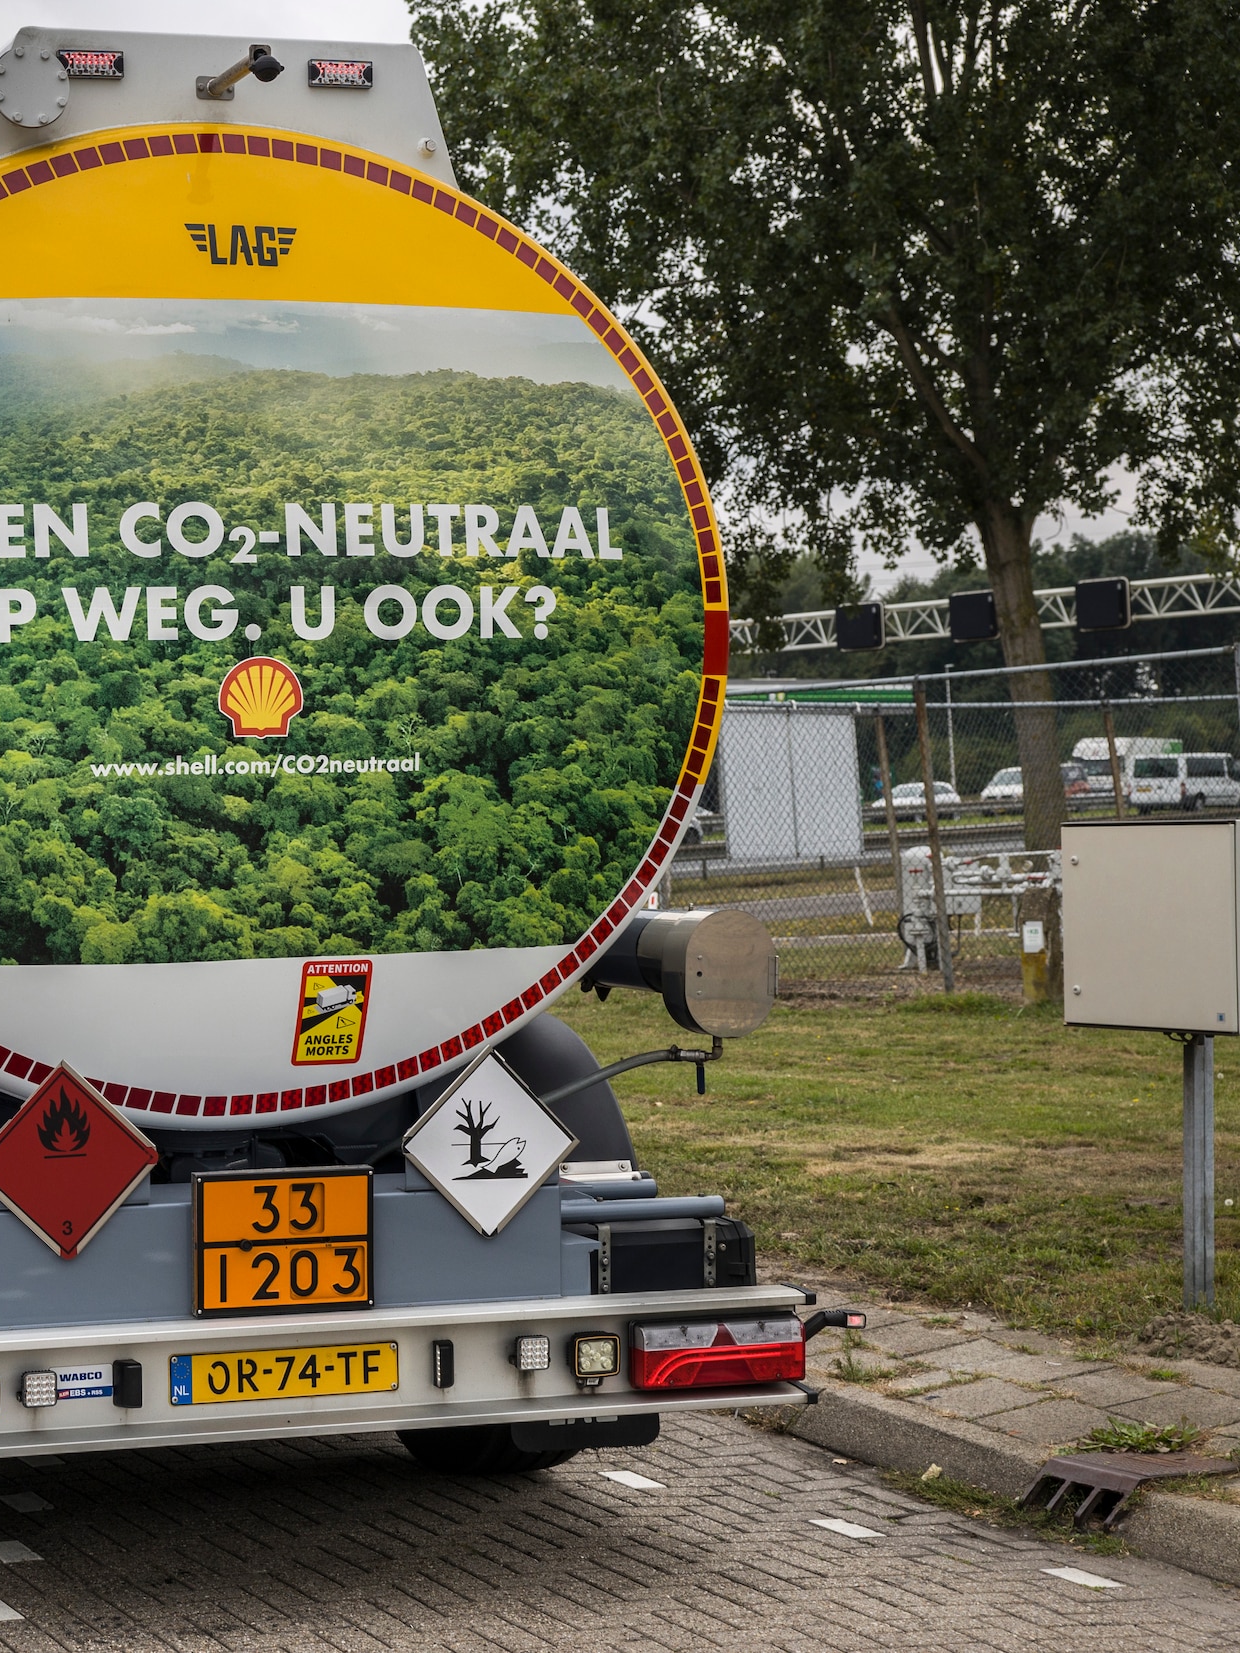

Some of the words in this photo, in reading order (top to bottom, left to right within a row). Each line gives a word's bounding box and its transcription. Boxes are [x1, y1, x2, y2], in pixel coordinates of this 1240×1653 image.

[207, 223, 279, 267] LAG
[61, 584, 262, 642] WEG.
[290, 585, 336, 641] U
[363, 584, 557, 641] OOK?
[90, 752, 420, 777] www.shell.com/CO2neutraal
[307, 963, 369, 974] ATTENTION
[305, 1034, 354, 1045] ANGLES
[305, 1045, 350, 1057] MORTS
[251, 1182, 318, 1234] 33
[62, 1220, 73, 1236] 3
[219, 1247, 361, 1303] 1203
[59, 1371, 103, 1382] WABCO
[207, 1349, 381, 1395] OR-74-TF
[70, 1388, 87, 1397] EBS
[173, 1385, 190, 1397] NL
